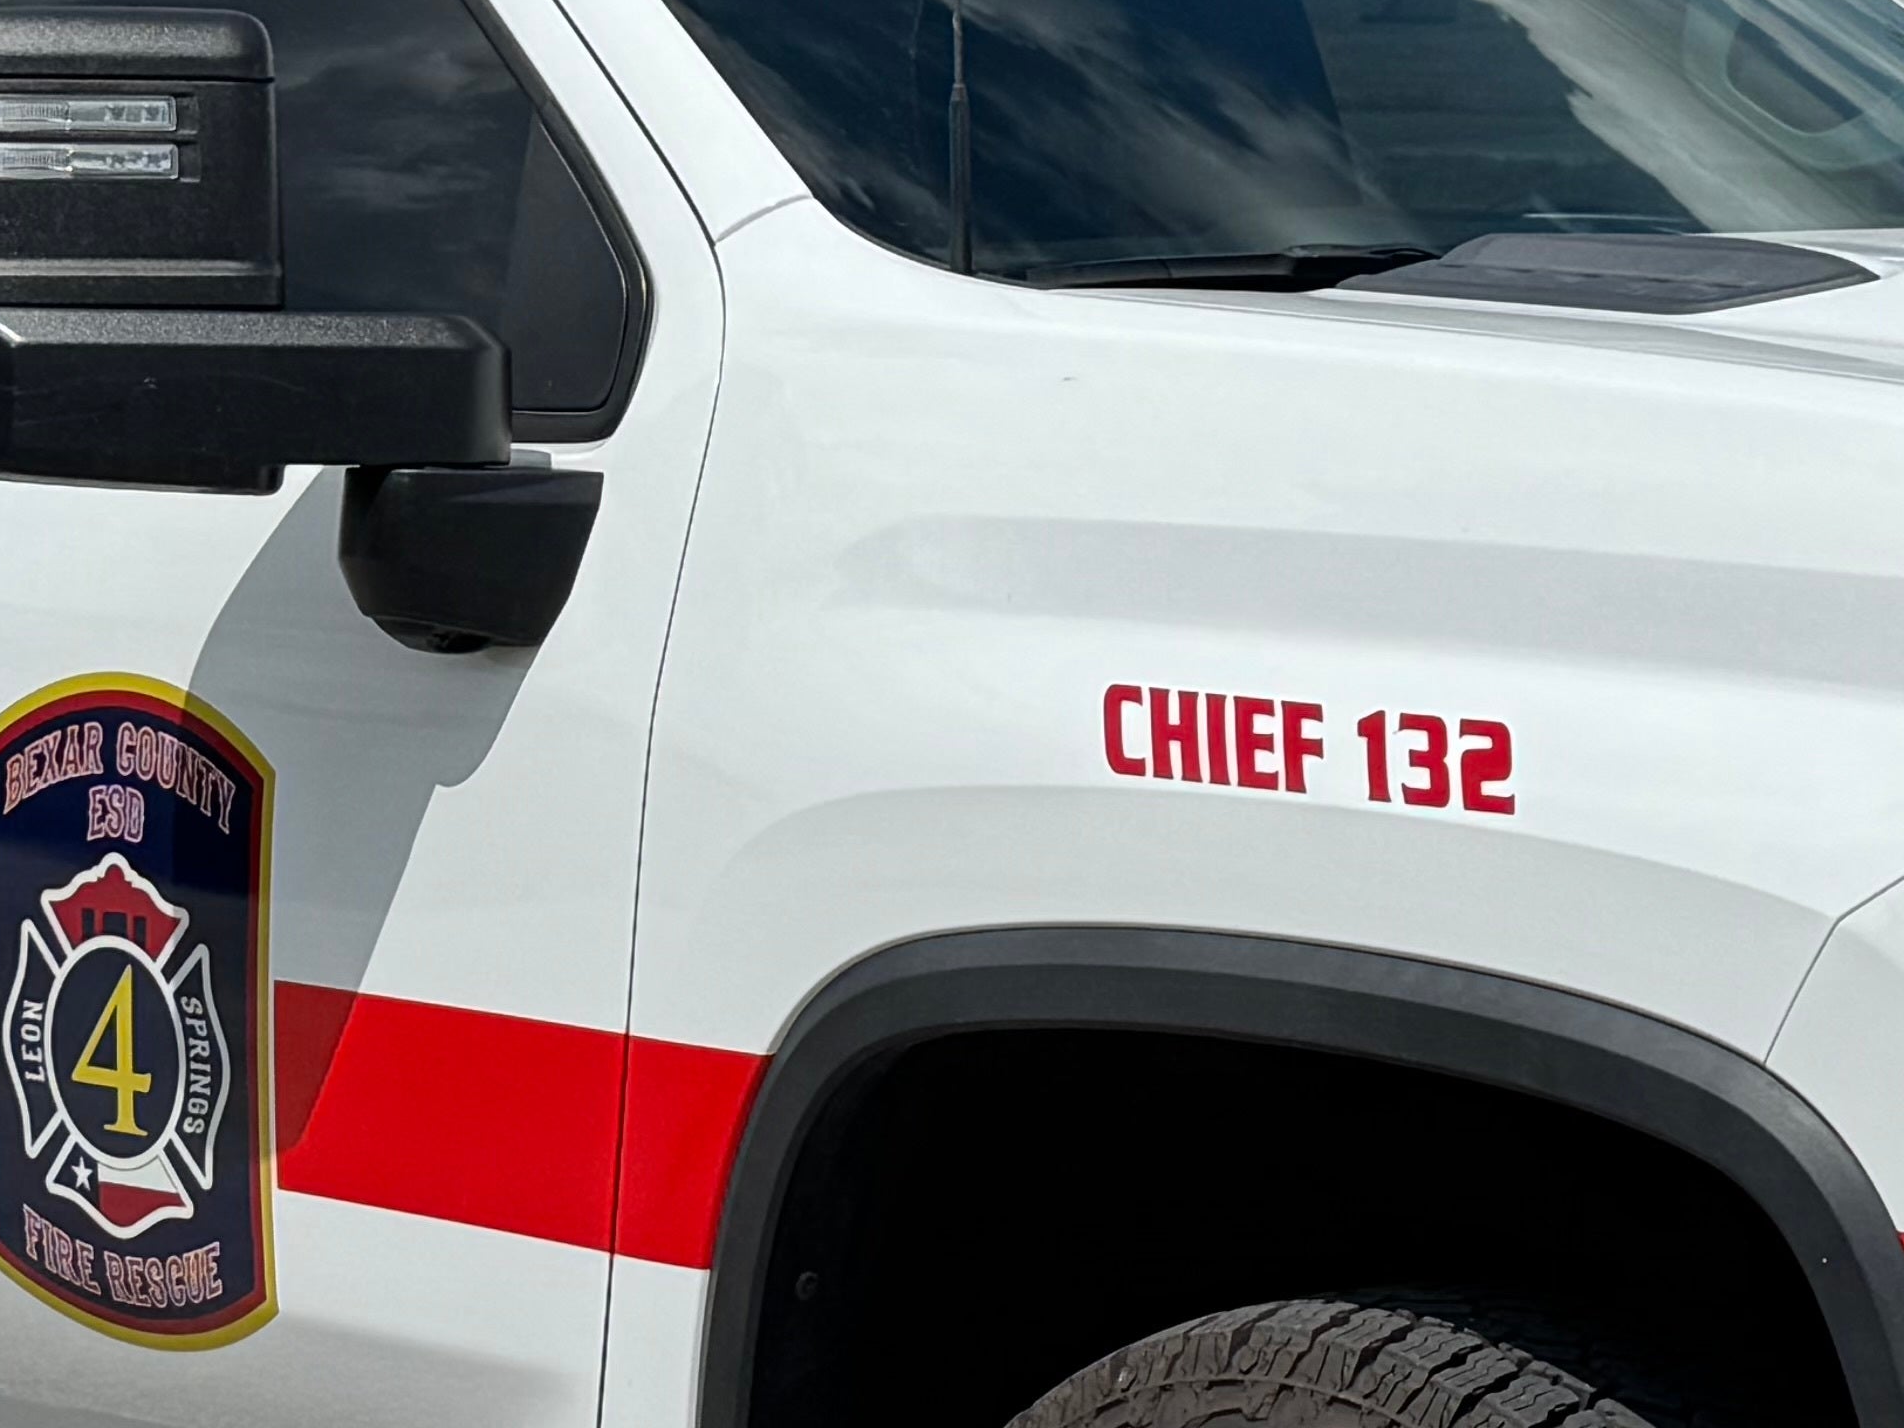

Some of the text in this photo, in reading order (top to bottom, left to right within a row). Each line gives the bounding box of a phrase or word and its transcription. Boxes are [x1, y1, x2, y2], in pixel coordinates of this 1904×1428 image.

[2, 721, 236, 834] BEXAR COUNTY
[1102, 683, 1516, 815] CHIEF 132
[87, 784, 145, 843] ESD
[24, 998, 45, 1083] LEON
[71, 963, 152, 1137] 4
[181, 994, 213, 1135] SPRINGS
[22, 1204, 224, 1308] FIRE RESCUE
